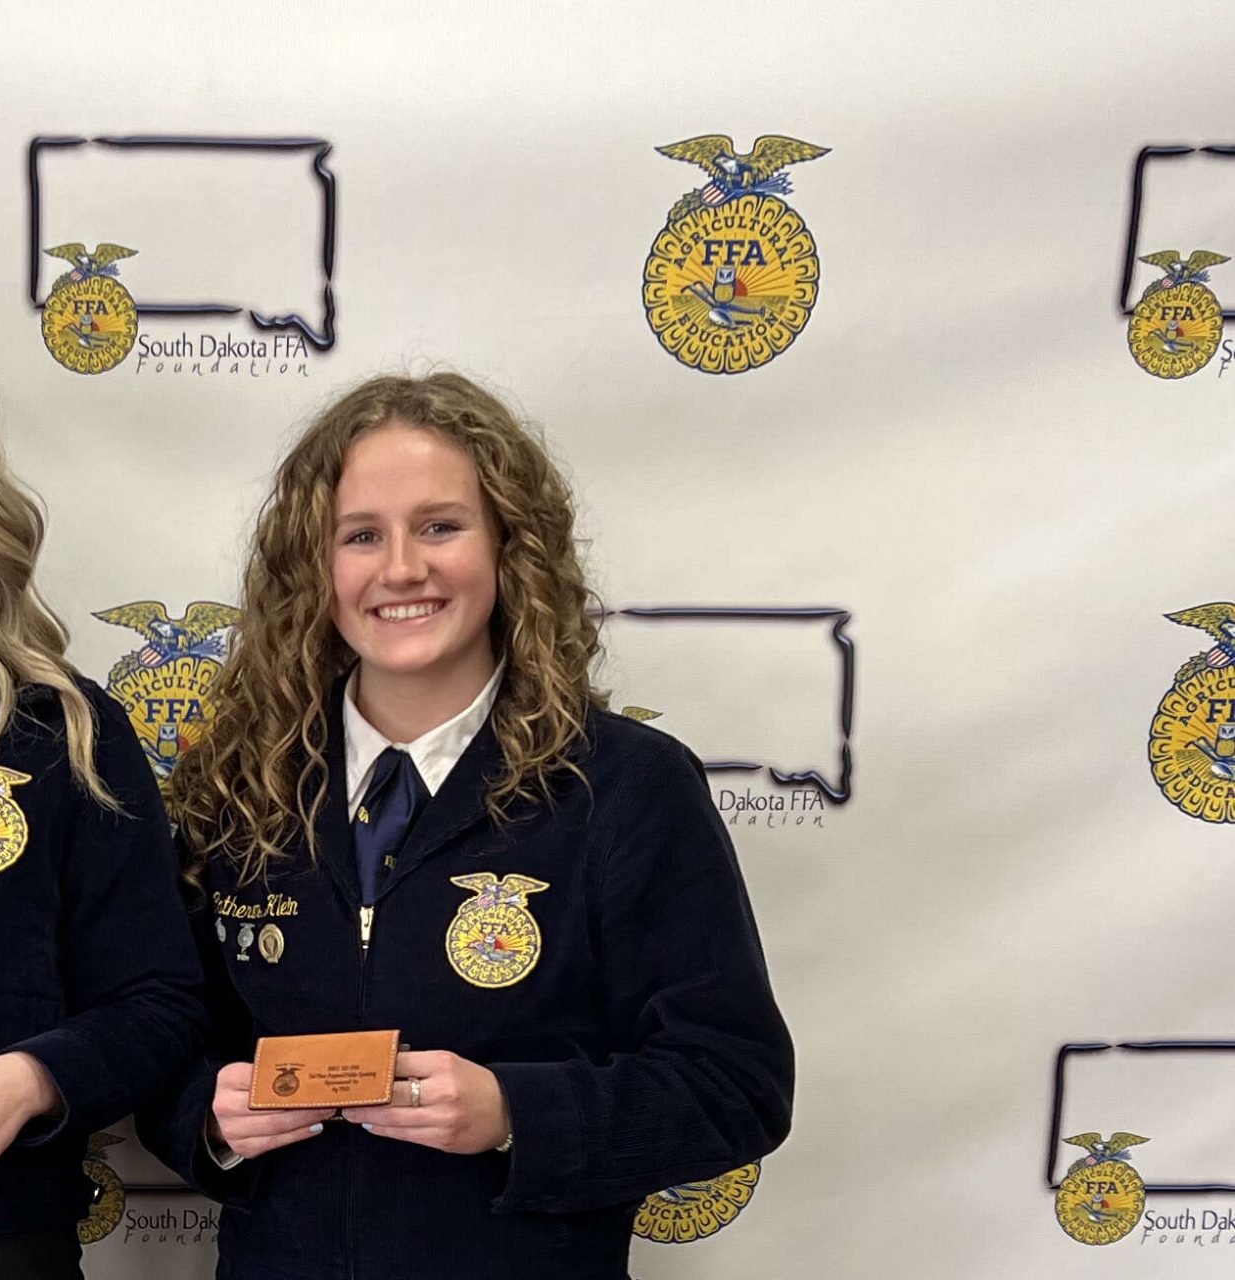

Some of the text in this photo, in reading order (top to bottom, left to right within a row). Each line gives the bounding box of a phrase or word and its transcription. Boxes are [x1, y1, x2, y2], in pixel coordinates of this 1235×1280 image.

[672, 216, 792, 271] AGRICULTURAL
[701, 240, 769, 266] FFA
[73, 301, 109, 315] FFA
[1161, 306, 1196, 321] FFA
[677, 312, 779, 348] EDUCATION
[138, 332, 309, 359] South Dakota FFA
[136, 354, 310, 378] Foundation
[144, 699, 206, 723] FFA
[719, 787, 825, 811] Dakota FFA
[729, 810, 825, 829] dation
[1086, 1181, 1118, 1194] FFA
[125, 1207, 218, 1230] South Dak
[1144, 1208, 1235, 1230] South Dak
